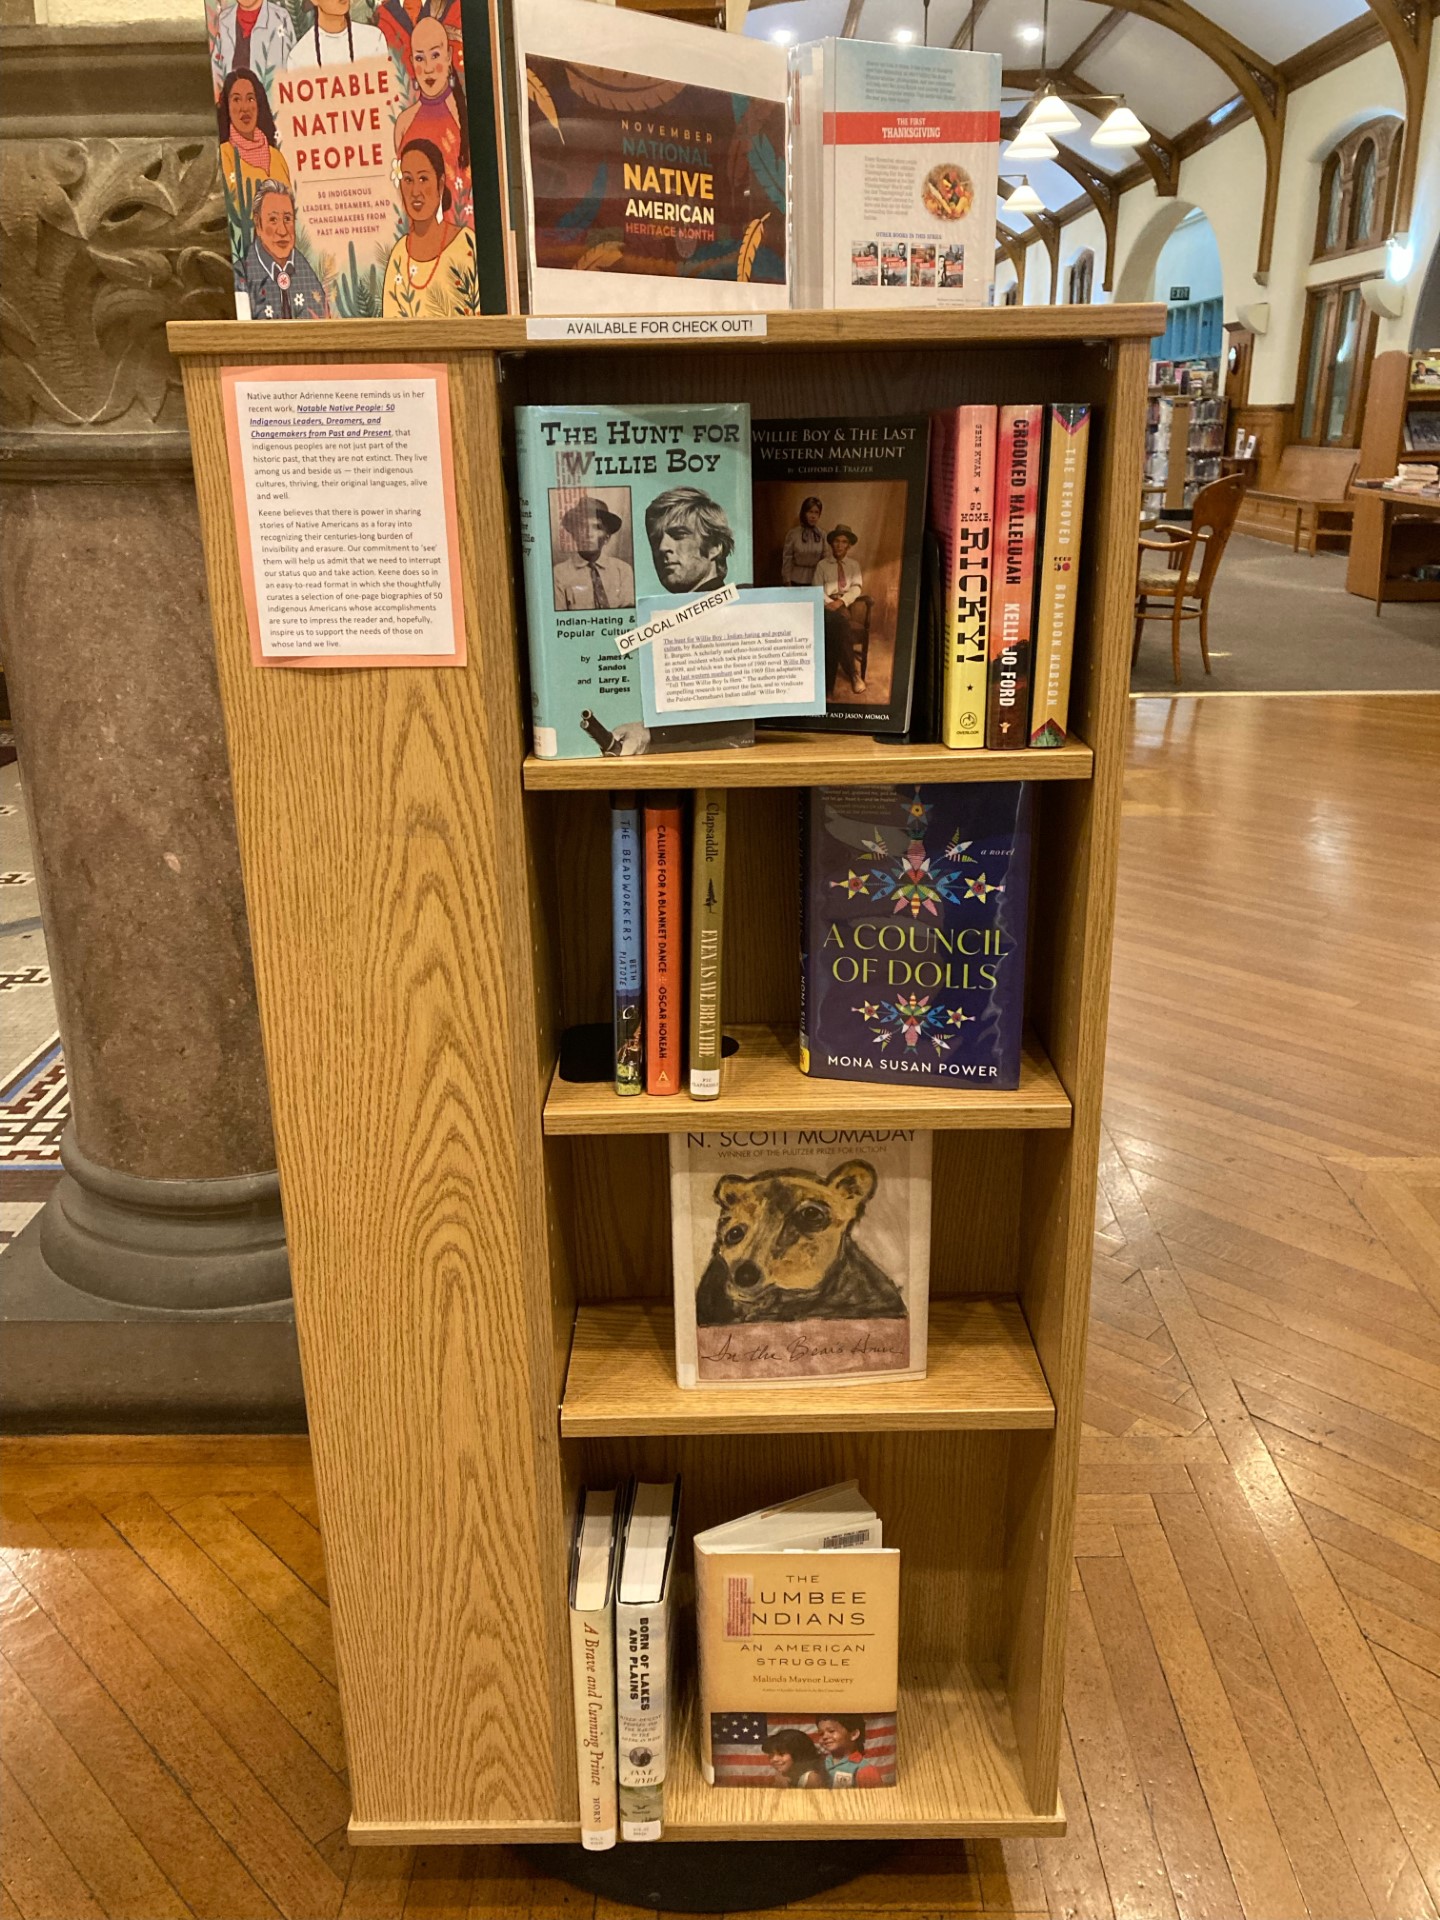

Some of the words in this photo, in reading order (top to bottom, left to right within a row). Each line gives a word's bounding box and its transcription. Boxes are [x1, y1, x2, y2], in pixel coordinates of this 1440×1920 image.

[278, 71, 389, 104] NOTABLE
[292, 108, 380, 137] NATIVE
[622, 120, 712, 144] NOVEMBER
[882, 127, 940, 139] THANKSGIVING
[296, 144, 383, 171] PEOPLE
[623, 138, 711, 167] NATIONAL
[318, 191, 326, 199] 50
[328, 188, 371, 197] INDIGENOUS
[624, 163, 714, 200] NATIVE
[302, 204, 332, 212] LEADERS,
[335, 201, 373, 210] DREAMERS,
[309, 214, 363, 224] CHANGEMAKERS
[366, 213, 386, 221] FROM
[625, 199, 714, 225] AMERICAN
[317, 228, 333, 236] PAST
[334, 227, 349, 235] AND
[352, 226, 379, 234] PRESENT
[626, 222, 676, 238] HERITAGE
[678, 226, 714, 241] MONTH
[567, 322, 638, 334] AVAILABLE
[641, 321, 668, 333] FOR
[672, 320, 717, 332] CHECK
[722, 320, 753, 332] OUT!
[247, 392, 271, 400] Native
[273, 392, 297, 400] author
[300, 391, 333, 399] Adrienne
[335, 391, 359, 399] Keene
[361, 391, 391, 399] reminds
[249, 405, 272, 413] recent
[297, 404, 327, 412] Notable
[329, 404, 354, 412] Native
[355, 404, 383, 413] People:
[250, 418, 291, 427] Indigenous
[293, 417, 324, 425] Leaders,
[326, 417, 365, 425] Dreamers,
[367, 417, 381, 425] and
[251, 430, 307, 438] Changemakers
[308, 430, 327, 438] from
[329, 429, 345, 437] Past
[347, 429, 361, 437] and
[752, 430, 797, 442] WILLIE
[803, 428, 831, 442] BOY
[834, 428, 844, 440] &
[850, 428, 878, 440] THE
[883, 428, 916, 440] LAST
[974, 424, 982, 448] GENE
[761, 448, 824, 460] WESTERN
[829, 447, 905, 459] MANHUNT
[1011, 419, 1029, 487] CROOKED
[1064, 448, 1076, 472] THE
[1059, 482, 1074, 544] REMOVED
[1006, 495, 1025, 585] HALLELUJAH
[957, 527, 989, 663] RICKY!
[556, 616, 623, 626] Indian-Hating
[629, 615, 635, 624] &
[620, 635, 635, 649] OF
[637, 619, 675, 641] LOCAL
[676, 589, 732, 623] INTEREST!
[1003, 604, 1020, 640] KELLI
[1051, 584, 1066, 646] BRANDON
[557, 628, 595, 639] Popular
[581, 655, 590, 663] by
[598, 654, 621, 662] James
[598, 663, 626, 671] Sandos
[1002, 647, 1017, 665] JO
[577, 677, 591, 685] and
[599, 677, 619, 685] Larry
[599, 685, 630, 695] Burgess
[999, 672, 1016, 706] FORD
[1047, 654, 1060, 705] HOBSON
[620, 820, 630, 840] THE
[702, 803, 719, 862] Clapsaddle
[657, 825, 666, 866] CALLING
[989, 848, 1015, 856] novel
[658, 869, 666, 888] FOR
[658, 900, 666, 939] BLANKET
[701, 930, 718, 960] EVEN
[823, 923, 843, 948] A
[853, 923, 1009, 956] COUNCIL
[619, 951, 627, 985] PIATOTE
[657, 942, 667, 973] DANCE
[701, 963, 717, 978] AS
[832, 957, 878, 983] OF
[888, 959, 998, 990] DOLLS
[700, 981, 716, 1001] WE
[659, 987, 667, 1020] OSCAR
[659, 1023, 667, 1059] HOKEAH
[699, 1004, 716, 1058] BREATHE
[828, 1055, 873, 1069] MONA
[880, 1059, 931, 1073] SUSAN
[939, 1063, 998, 1077] POWER
[687, 1132, 710, 1148] N.
[744, 1345, 782, 1361] the
[786, 1575, 819, 1583] THE
[584, 1622, 599, 1635] A
[629, 1628, 638, 1653] AND
[640, 1617, 649, 1651] BORN
[585, 1639, 599, 1673] Brave
[740, 1644, 762, 1652] AN
[774, 1644, 866, 1652] AMERICAN
[640, 1654, 649, 1669] OF
[757, 1658, 850, 1666] STRUGGLE
[586, 1676, 600, 1698] and
[629, 1656, 638, 1700] PLAINS
[753, 1675, 787, 1684] Malinda
[789, 1675, 821, 1684] Maynor
[823, 1675, 853, 1685] Lowery
[640, 1672, 650, 1711] LAKES
[583, 1702, 603, 1749] Cunning
[590, 1751, 604, 1786] Prince
[593, 1798, 601, 1823] HORN
